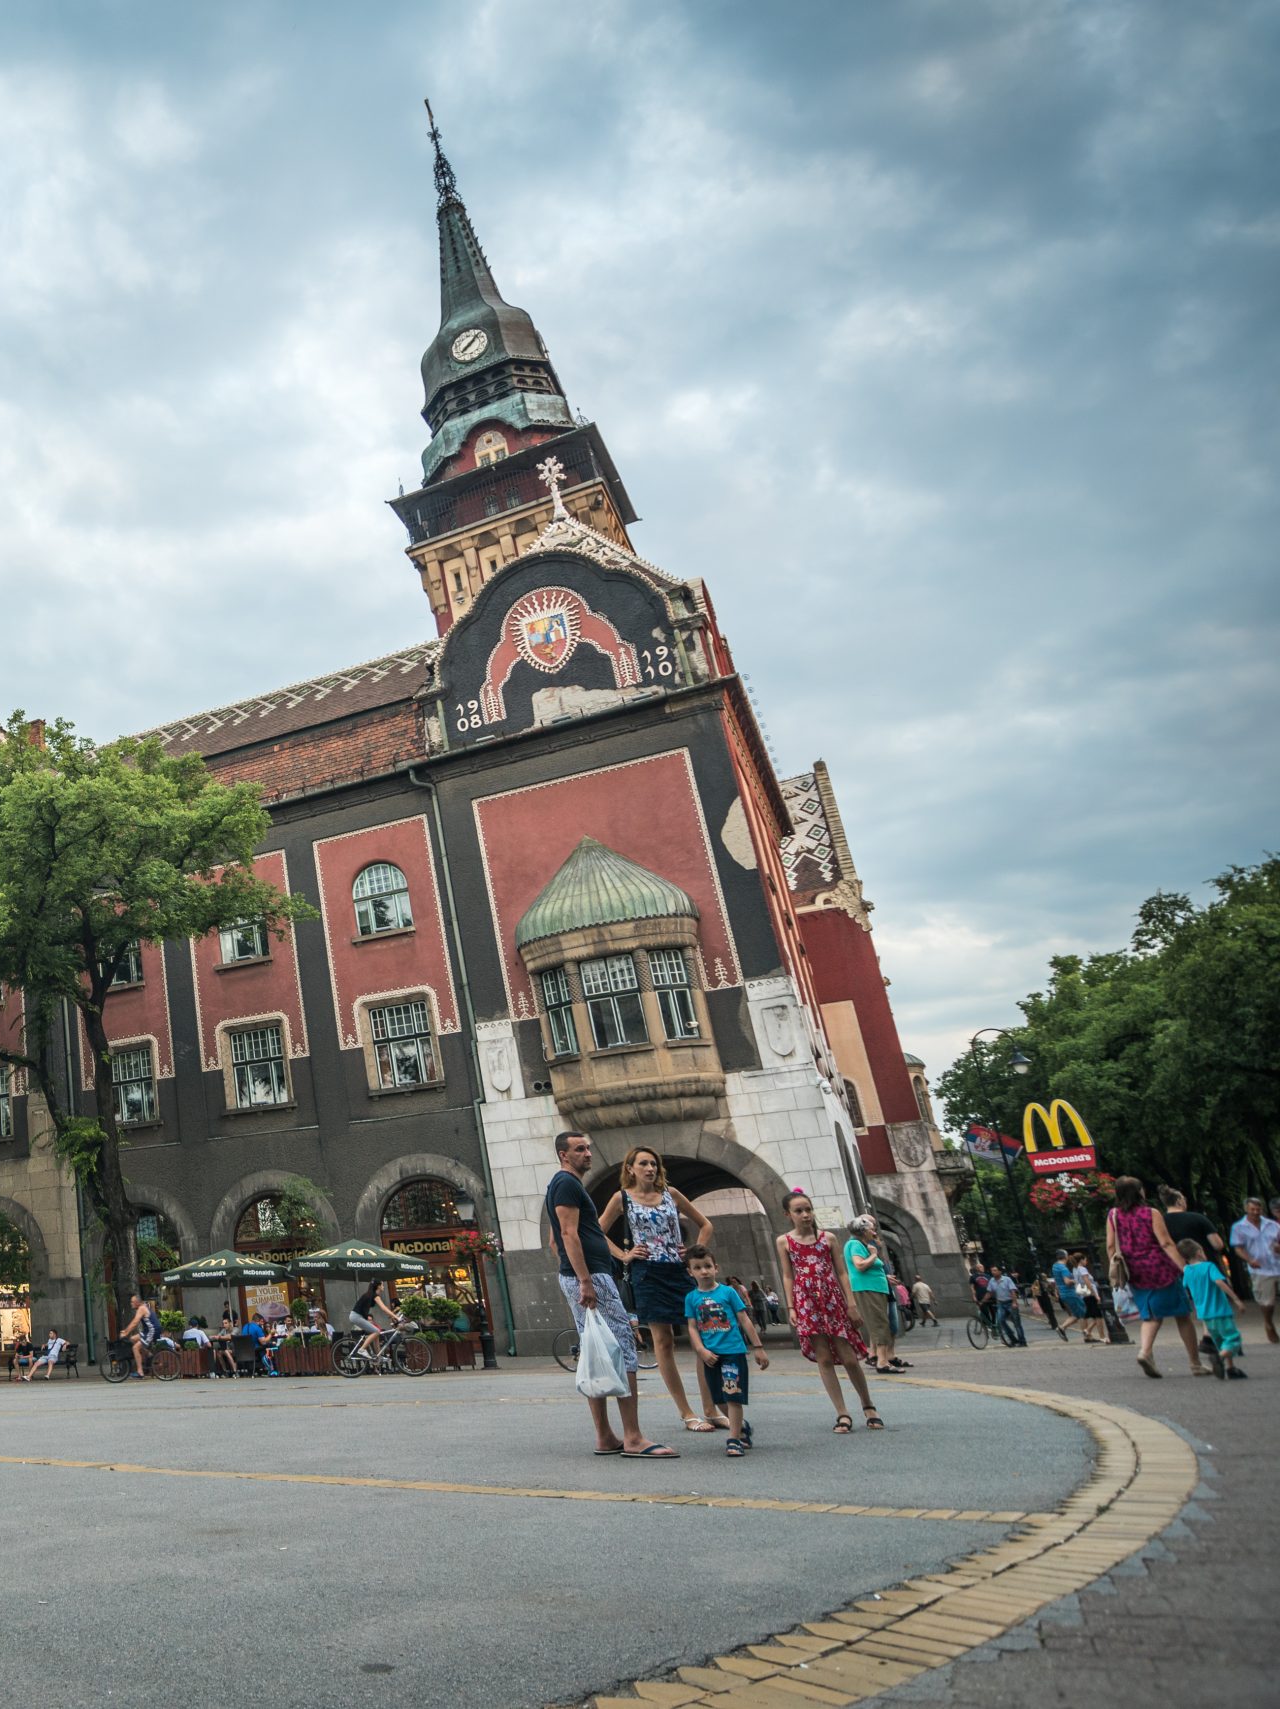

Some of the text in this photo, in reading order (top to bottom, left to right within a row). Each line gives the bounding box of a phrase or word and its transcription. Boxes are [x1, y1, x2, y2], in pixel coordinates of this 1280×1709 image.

[642, 645, 669, 664] 19
[644, 661, 673, 680] 10
[455, 699, 479, 717] 19
[456, 714, 483, 732] 08
[1033, 1153, 1092, 1167] McDonald's
[393, 1239, 451, 1254] McDona
[346, 1261, 386, 1269] McDonald's
[191, 1270, 227, 1279] McDonald's
[258, 1286, 279, 1296] YOUR
[251, 1294, 284, 1305] SUMMER!
